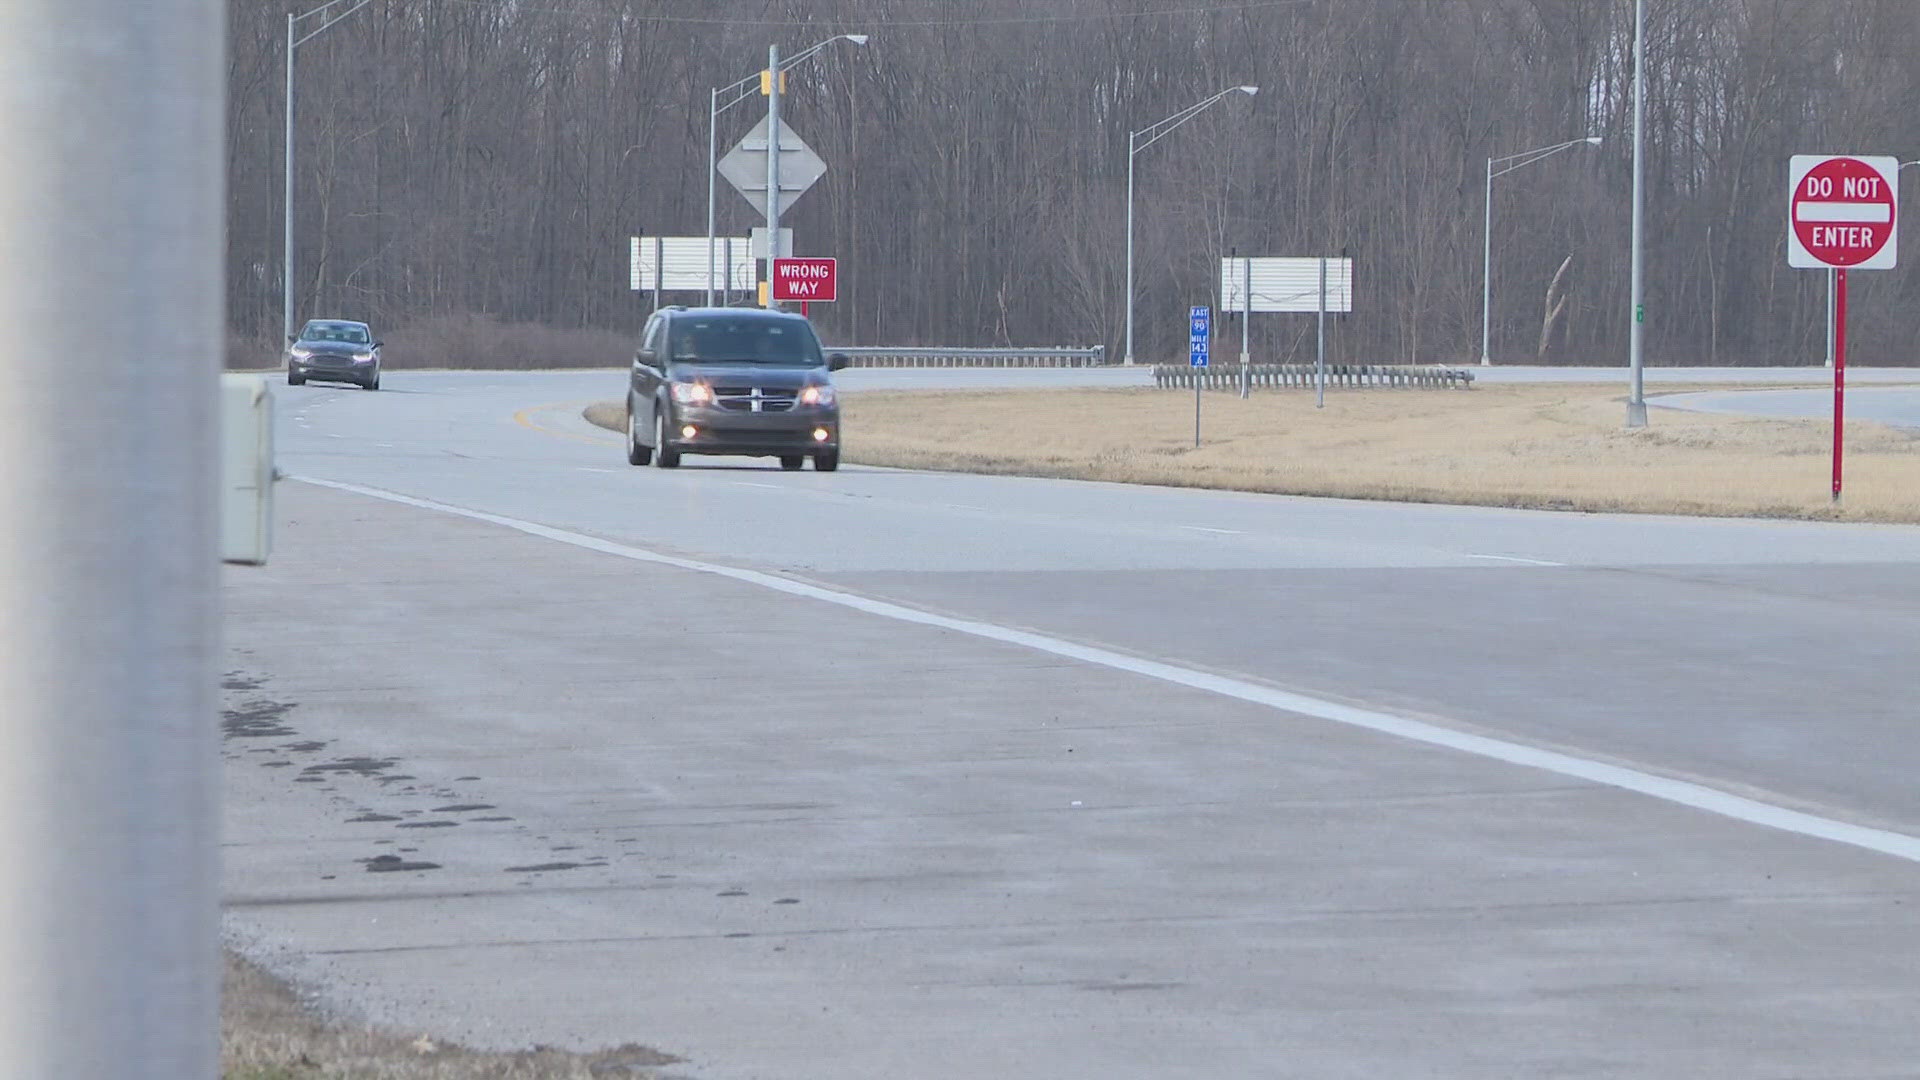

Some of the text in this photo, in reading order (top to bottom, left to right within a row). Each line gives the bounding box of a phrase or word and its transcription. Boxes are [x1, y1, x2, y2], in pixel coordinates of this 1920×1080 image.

[1807, 176, 1880, 198] DO NOT
[1812, 226, 1874, 248] ENTER
[780, 264, 829, 278] WRONG
[789, 281, 819, 295] WAY
[1191, 343, 1207, 352] 143
